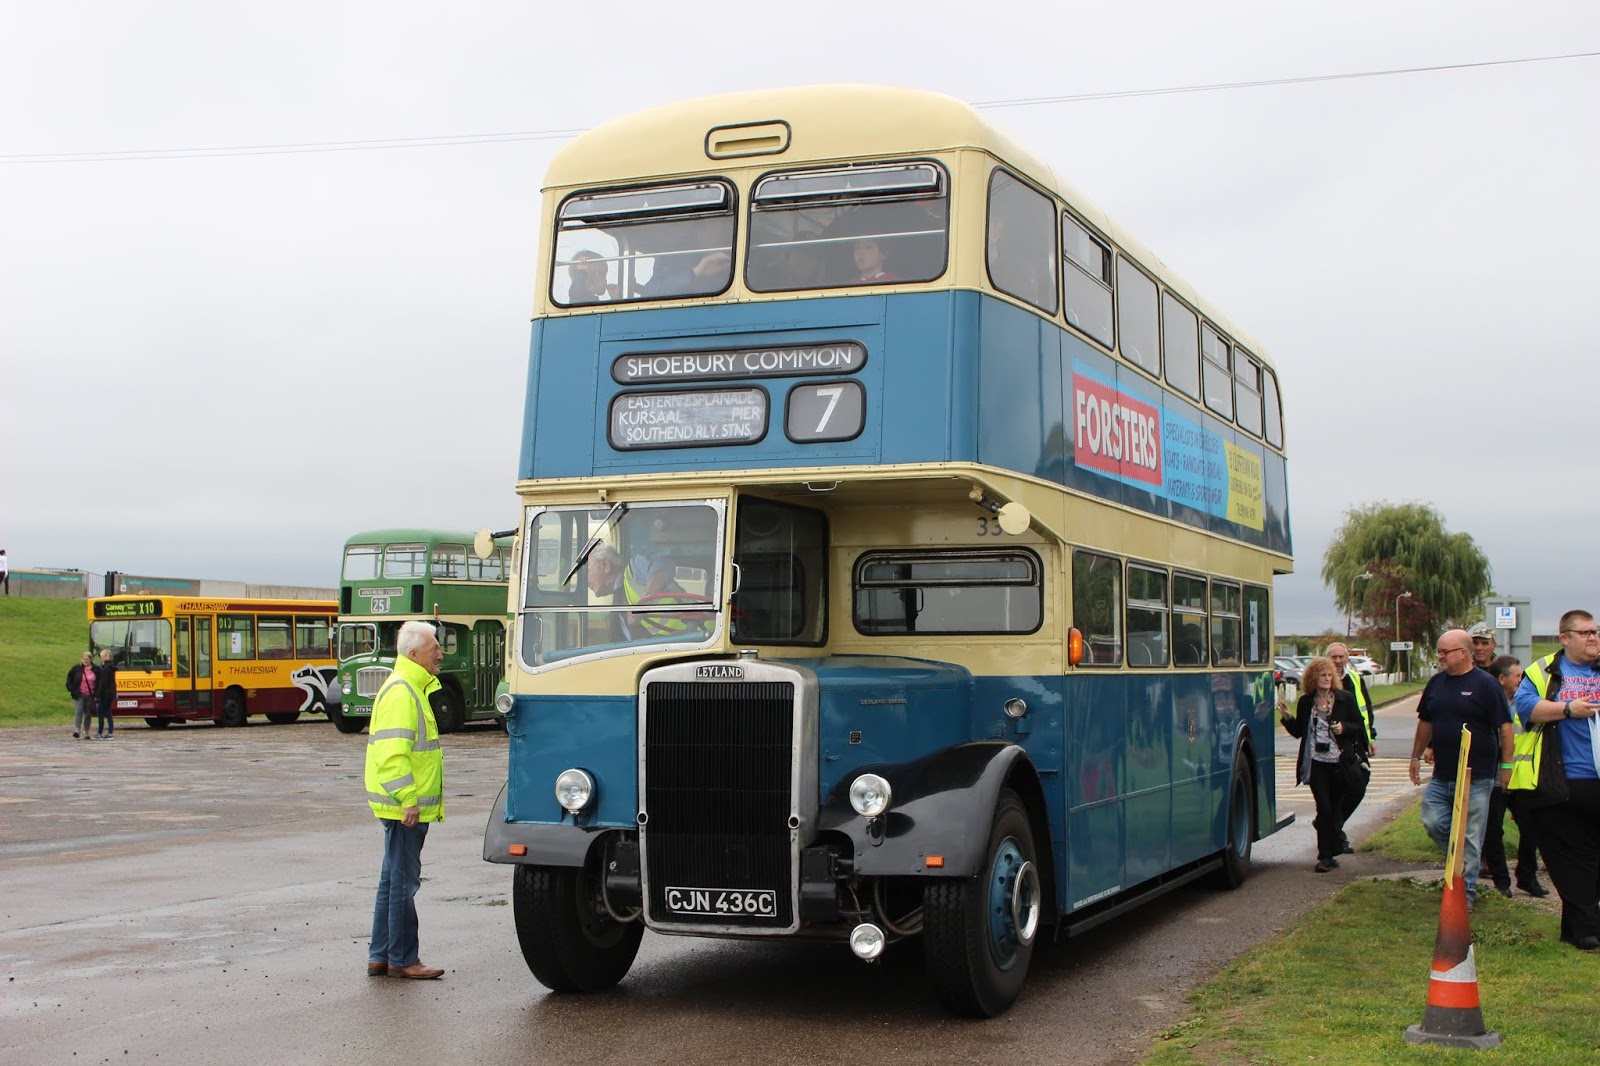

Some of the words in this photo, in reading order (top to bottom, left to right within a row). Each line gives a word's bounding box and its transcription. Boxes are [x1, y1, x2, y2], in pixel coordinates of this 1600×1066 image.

[627, 354, 736, 377] SHOEBURY
[743, 347, 852, 371] COMMON
[628, 396, 681, 409] EASTERN
[683, 392, 755, 407] ESPLANADE
[619, 410, 683, 425] KURSAAL
[731, 406, 761, 422] PIER
[815, 387, 844, 433] 7
[626, 425, 692, 441] SOUTHEND
[695, 425, 719, 439] RLY.
[721, 423, 752, 438] STNS.
[1076, 389, 1158, 471] FORSTERS
[105, 603, 125, 611] Canvey
[139, 602, 154, 615] X10
[180, 602, 229, 611] THAMESWAY
[229, 666, 279, 675] THAMESWAY
[696, 666, 743, 678] LEYLAND
[668, 890, 710, 911] CJN
[715, 892, 773, 913] 436C
